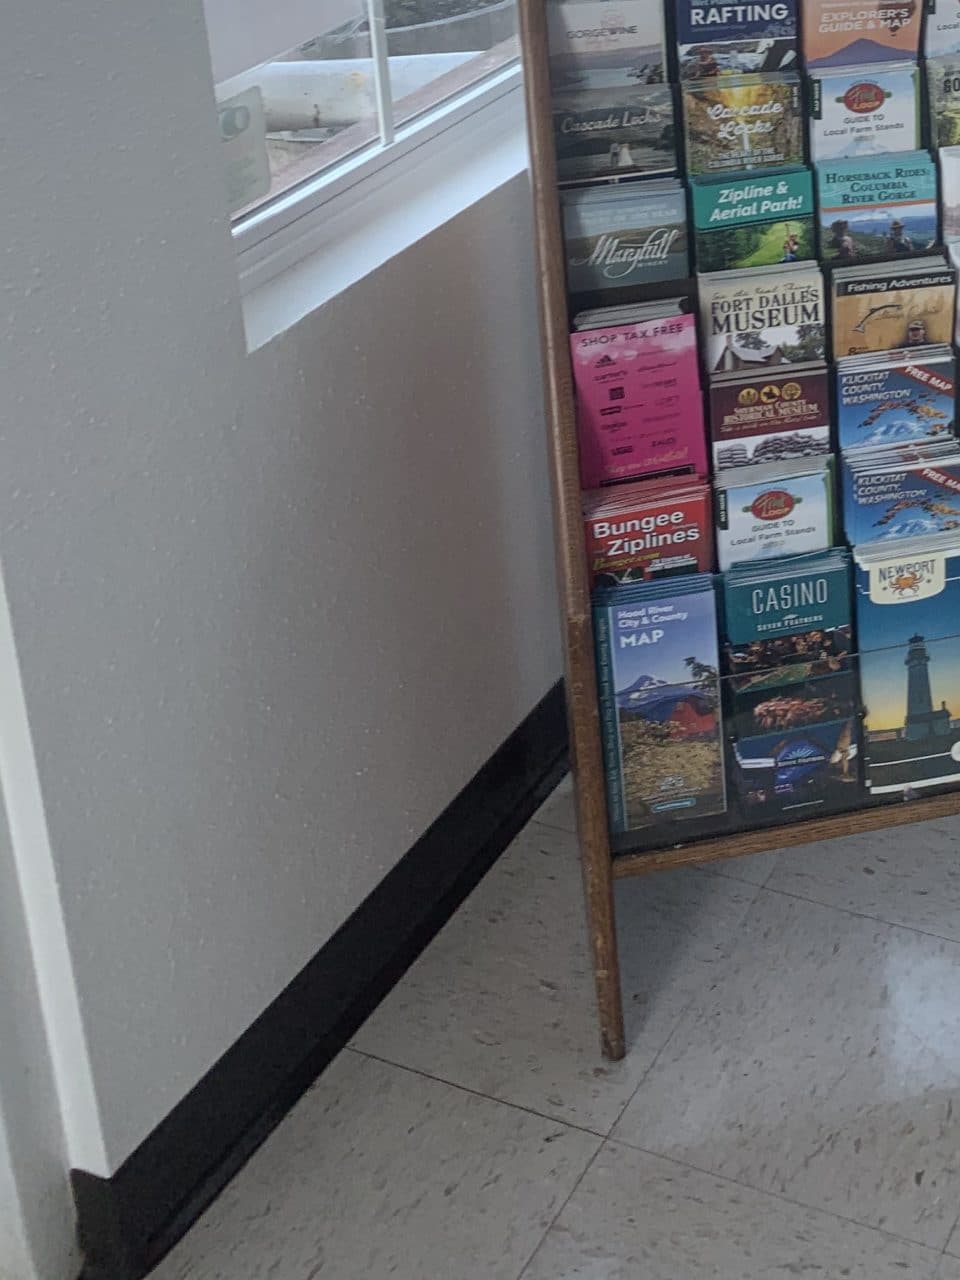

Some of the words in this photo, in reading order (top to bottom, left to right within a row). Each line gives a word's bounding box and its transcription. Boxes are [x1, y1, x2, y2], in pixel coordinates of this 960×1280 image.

[690, 3, 789, 26] RAFTING
[821, 8, 909, 23] EXPLORER'S
[818, 22, 864, 33] GUIDE
[866, 21, 875, 30] &
[879, 19, 912, 29] MAP
[707, 101, 784, 120] Cascade
[561, 116, 620, 134] Cascade
[717, 120, 774, 140] Locks
[718, 187, 772, 203] Zipline
[776, 181, 788, 194] &
[710, 204, 757, 222] Aerial
[761, 195, 803, 214] Park!
[570, 228, 684, 279] Maryhill
[848, 282, 887, 294] Fishing
[889, 276, 952, 289] Adventures
[711, 297, 753, 315] FORT
[759, 289, 820, 309] DALLES
[711, 303, 820, 336] MUSEUM
[581, 333, 617, 348] SHOP
[624, 329, 648, 342] TAX
[653, 322, 684, 337] FREE
[842, 371, 890, 385] KLICKITAT
[905, 366, 929, 382] FREE
[929, 375, 953, 391] MAP
[843, 389, 911, 405] WASHINGTON
[857, 472, 907, 486] KLICKITAT
[922, 468, 945, 483] FREE
[857, 489, 927, 505] WASHINGTON
[761, 507, 790, 518] LOOP
[593, 511, 684, 539] Bungee
[751, 522, 780, 532] GUIDE
[782, 519, 795, 528] TO
[607, 527, 700, 557] Ziplines
[730, 535, 756, 546] Local
[758, 531, 782, 542] Farm
[785, 526, 816, 537] Stands
[878, 559, 936, 582] NEWPORT
[752, 579, 828, 614] CASINO
[618, 607, 646, 620] Hood
[649, 604, 674, 616] River
[618, 618, 641, 629] City
[653, 610, 688, 624] County
[619, 629, 664, 648] MAP
